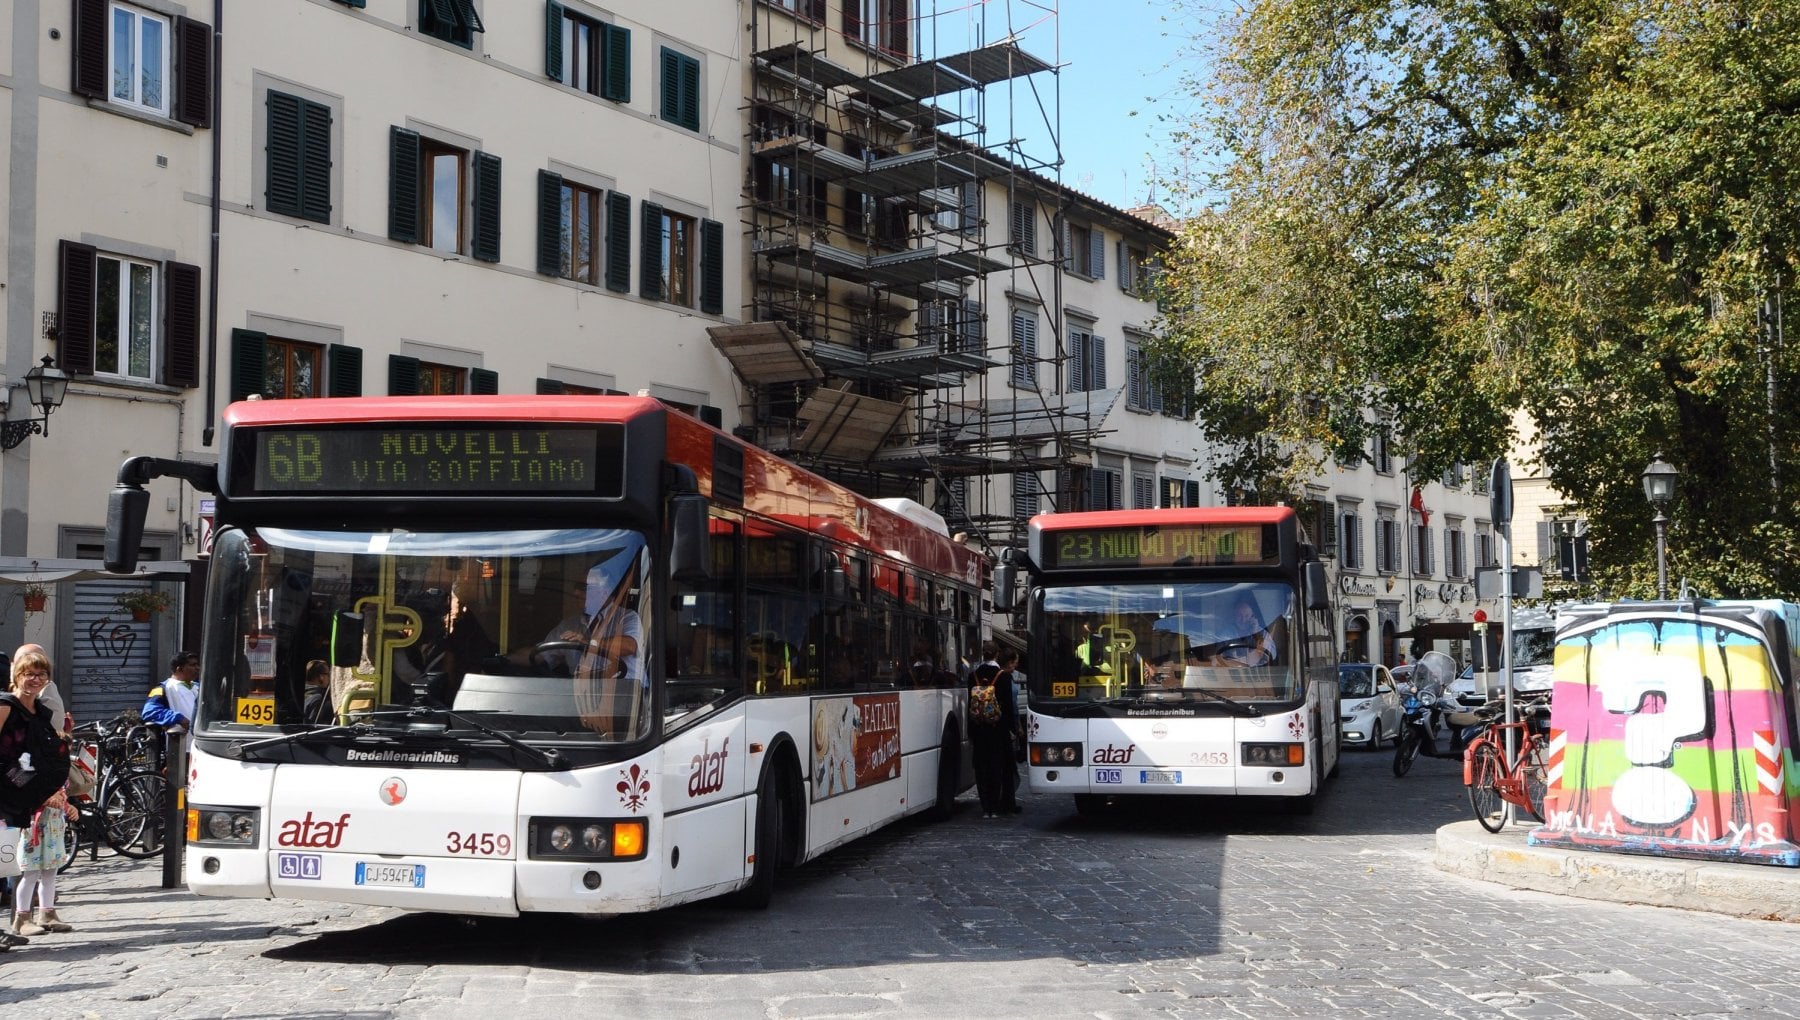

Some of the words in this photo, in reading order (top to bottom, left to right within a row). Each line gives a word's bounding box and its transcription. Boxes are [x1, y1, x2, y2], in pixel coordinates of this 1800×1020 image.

[381, 431, 551, 456] NOVELLI
[267, 433, 323, 482] 6B
[352, 459, 408, 481] VIA
[428, 458, 585, 481] SOFFIANO
[1060, 535, 1093, 559] 23
[1101, 532, 1165, 558] NUOVO
[1172, 530, 1257, 556] PIGNONE
[1054, 685, 1075, 695] 519
[240, 704, 273, 721] 495
[864, 701, 898, 733] EATALY
[1127, 708, 1195, 716] BredaMenarinibus
[346, 749, 459, 763] BredaMenarinibus
[1092, 744, 1135, 764] ataf
[1190, 752, 1228, 765] 3453
[688, 736, 729, 798] ataf
[278, 812, 350, 848] ataf
[446, 832, 511, 855] 3459
